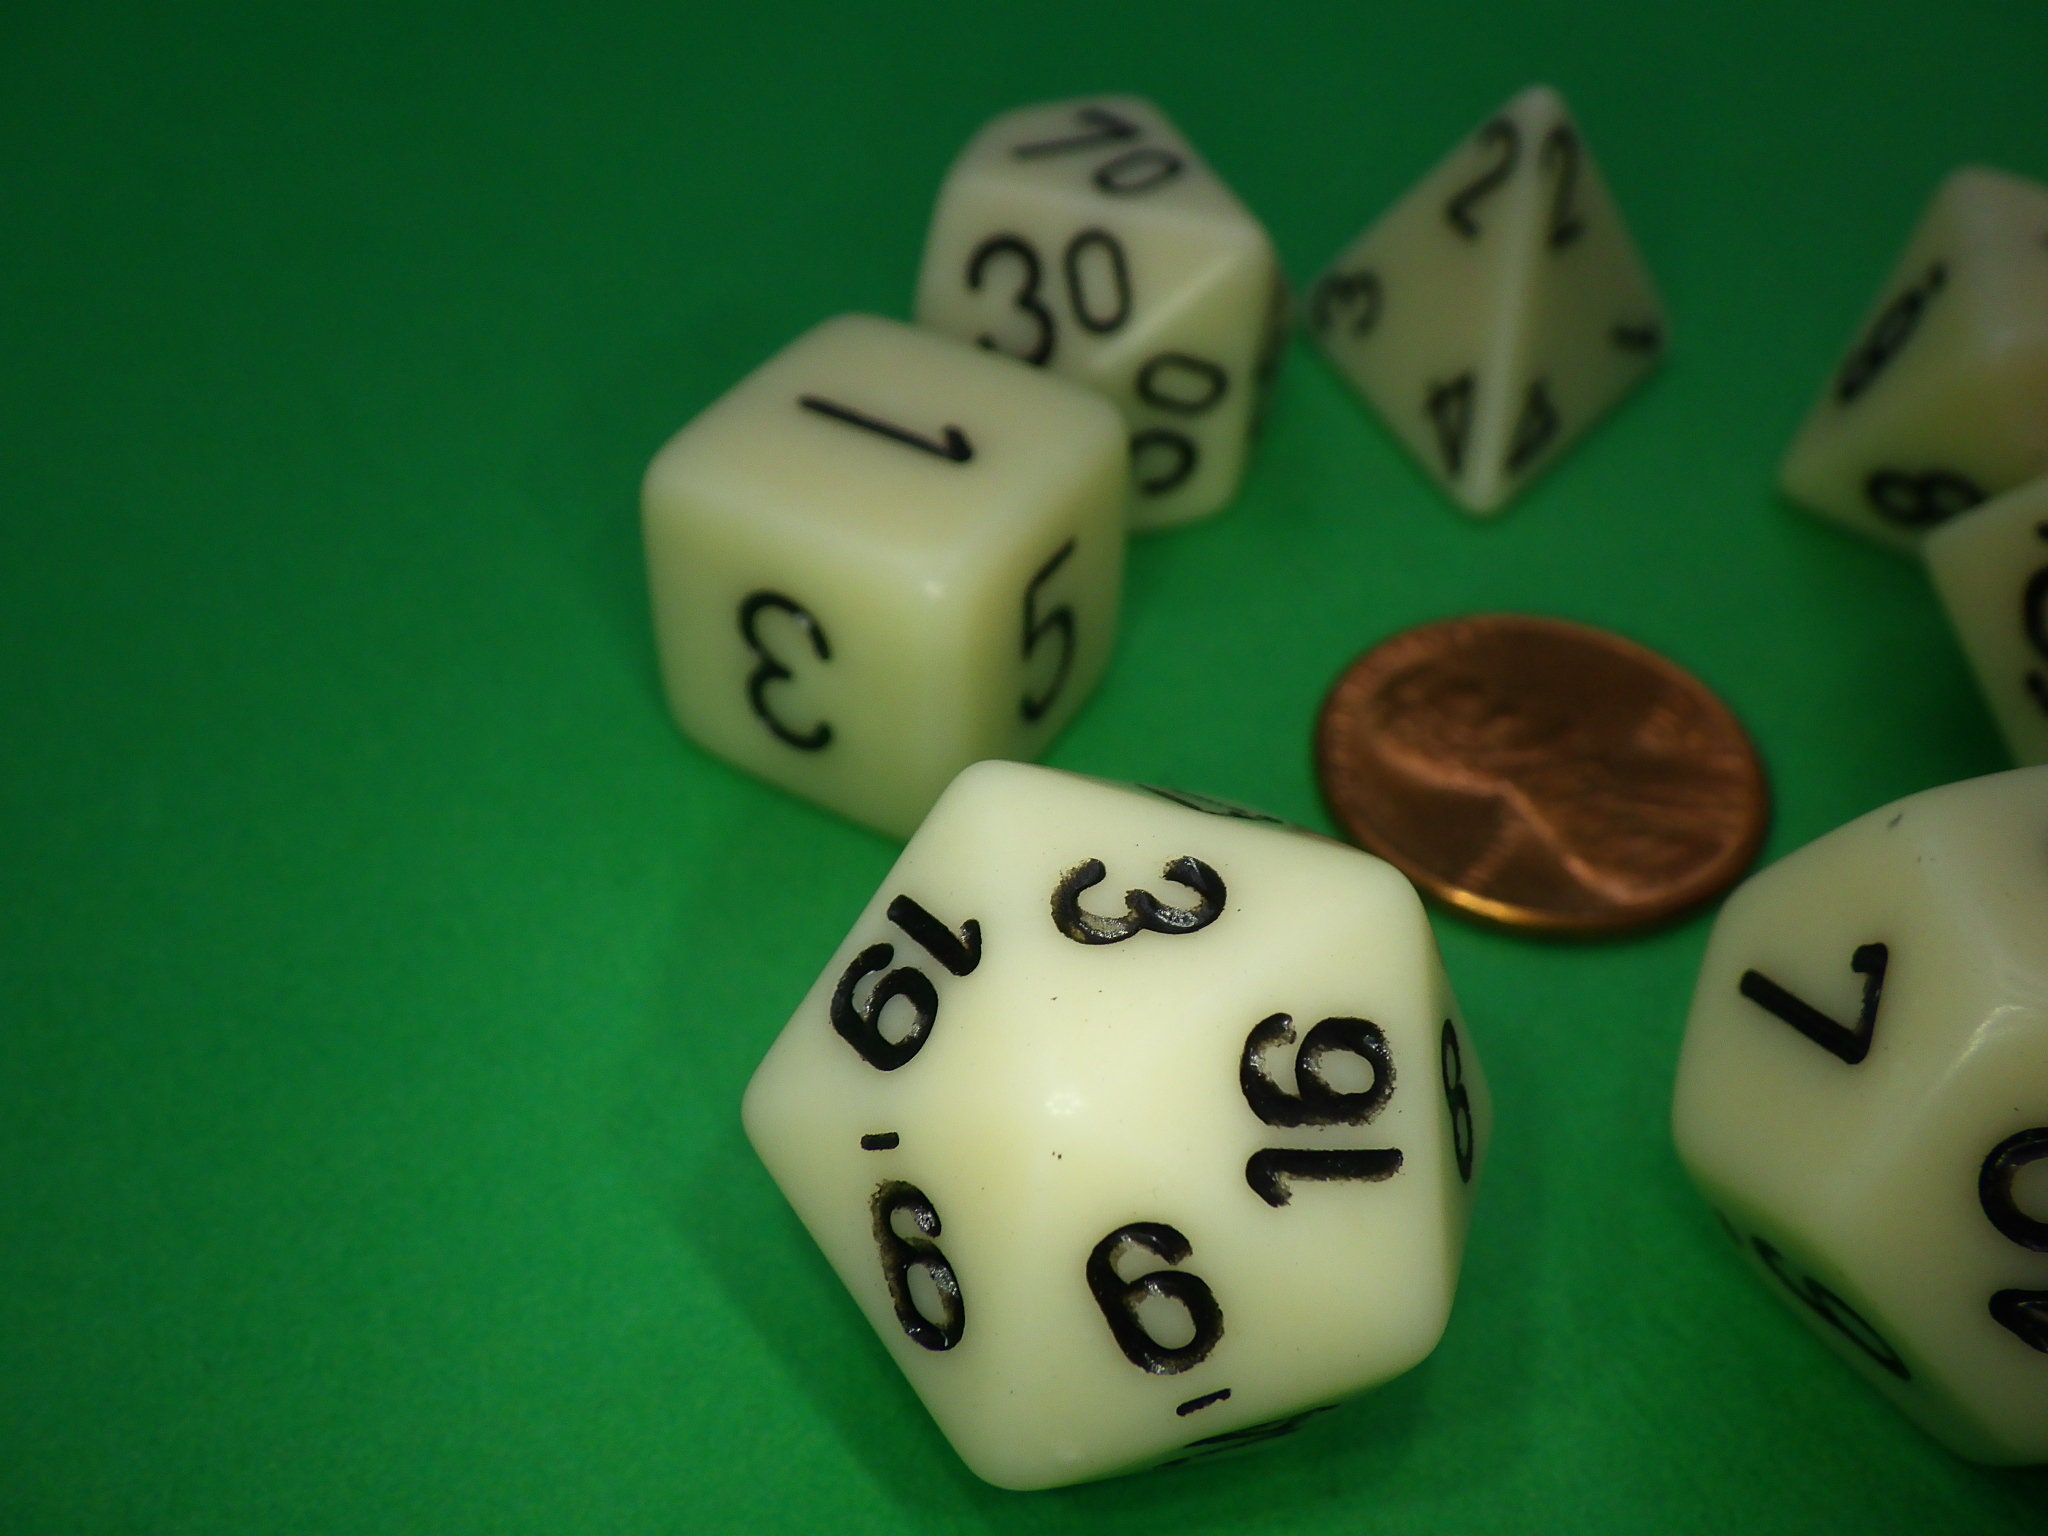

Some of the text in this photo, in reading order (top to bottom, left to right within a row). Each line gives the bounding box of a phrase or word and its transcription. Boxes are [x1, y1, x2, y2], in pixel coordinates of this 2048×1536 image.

[965, 227, 1131, 368] 30
[799, 394, 975, 464] 1
[736, 588, 831, 752] 3
[1021, 535, 1077, 722] 5
[1051, 855, 1228, 945] 3
[831, 894, 983, 1072] 19
[1738, 942, 1889, 1066] 7
[1239, 1012, 1404, 1208] 16
[1441, 1018, 1474, 1184] 8
